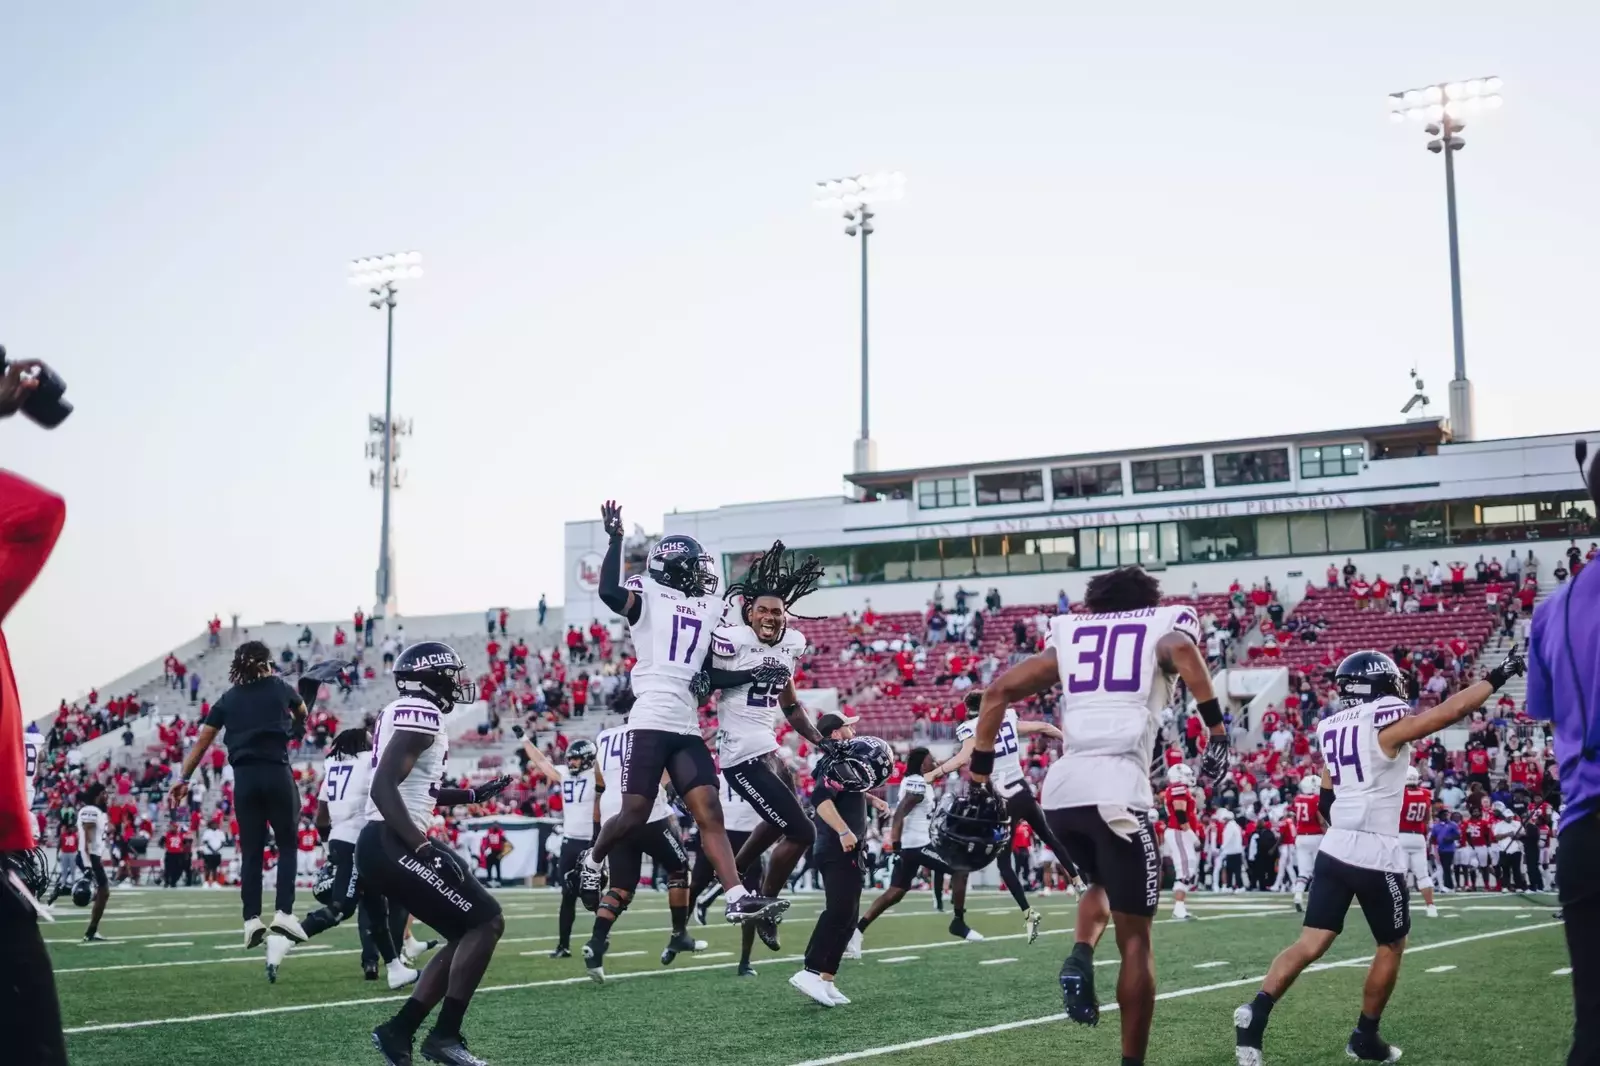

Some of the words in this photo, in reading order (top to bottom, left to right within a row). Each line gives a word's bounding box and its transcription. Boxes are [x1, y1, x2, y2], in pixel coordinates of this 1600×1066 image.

[994, 518, 1030, 533] AND
[1045, 512, 1120, 530] SANDRA
[1167, 503, 1230, 521] SMITH
[1246, 494, 1349, 515] PRESSBOX
[669, 614, 702, 664] 17
[412, 652, 454, 669] JACKS
[1068, 624, 1147, 694] 30
[601, 732, 625, 771] 74
[621, 731, 634, 792] UMBERJACKS
[1323, 725, 1364, 786] 34
[327, 765, 354, 801] 57
[563, 779, 588, 803] 97
[735, 772, 788, 829] LUMBERJACKS
[1295, 802, 1309, 821] 73
[1406, 802, 1427, 822] 60
[398, 854, 473, 912] LUMBERJACKS
